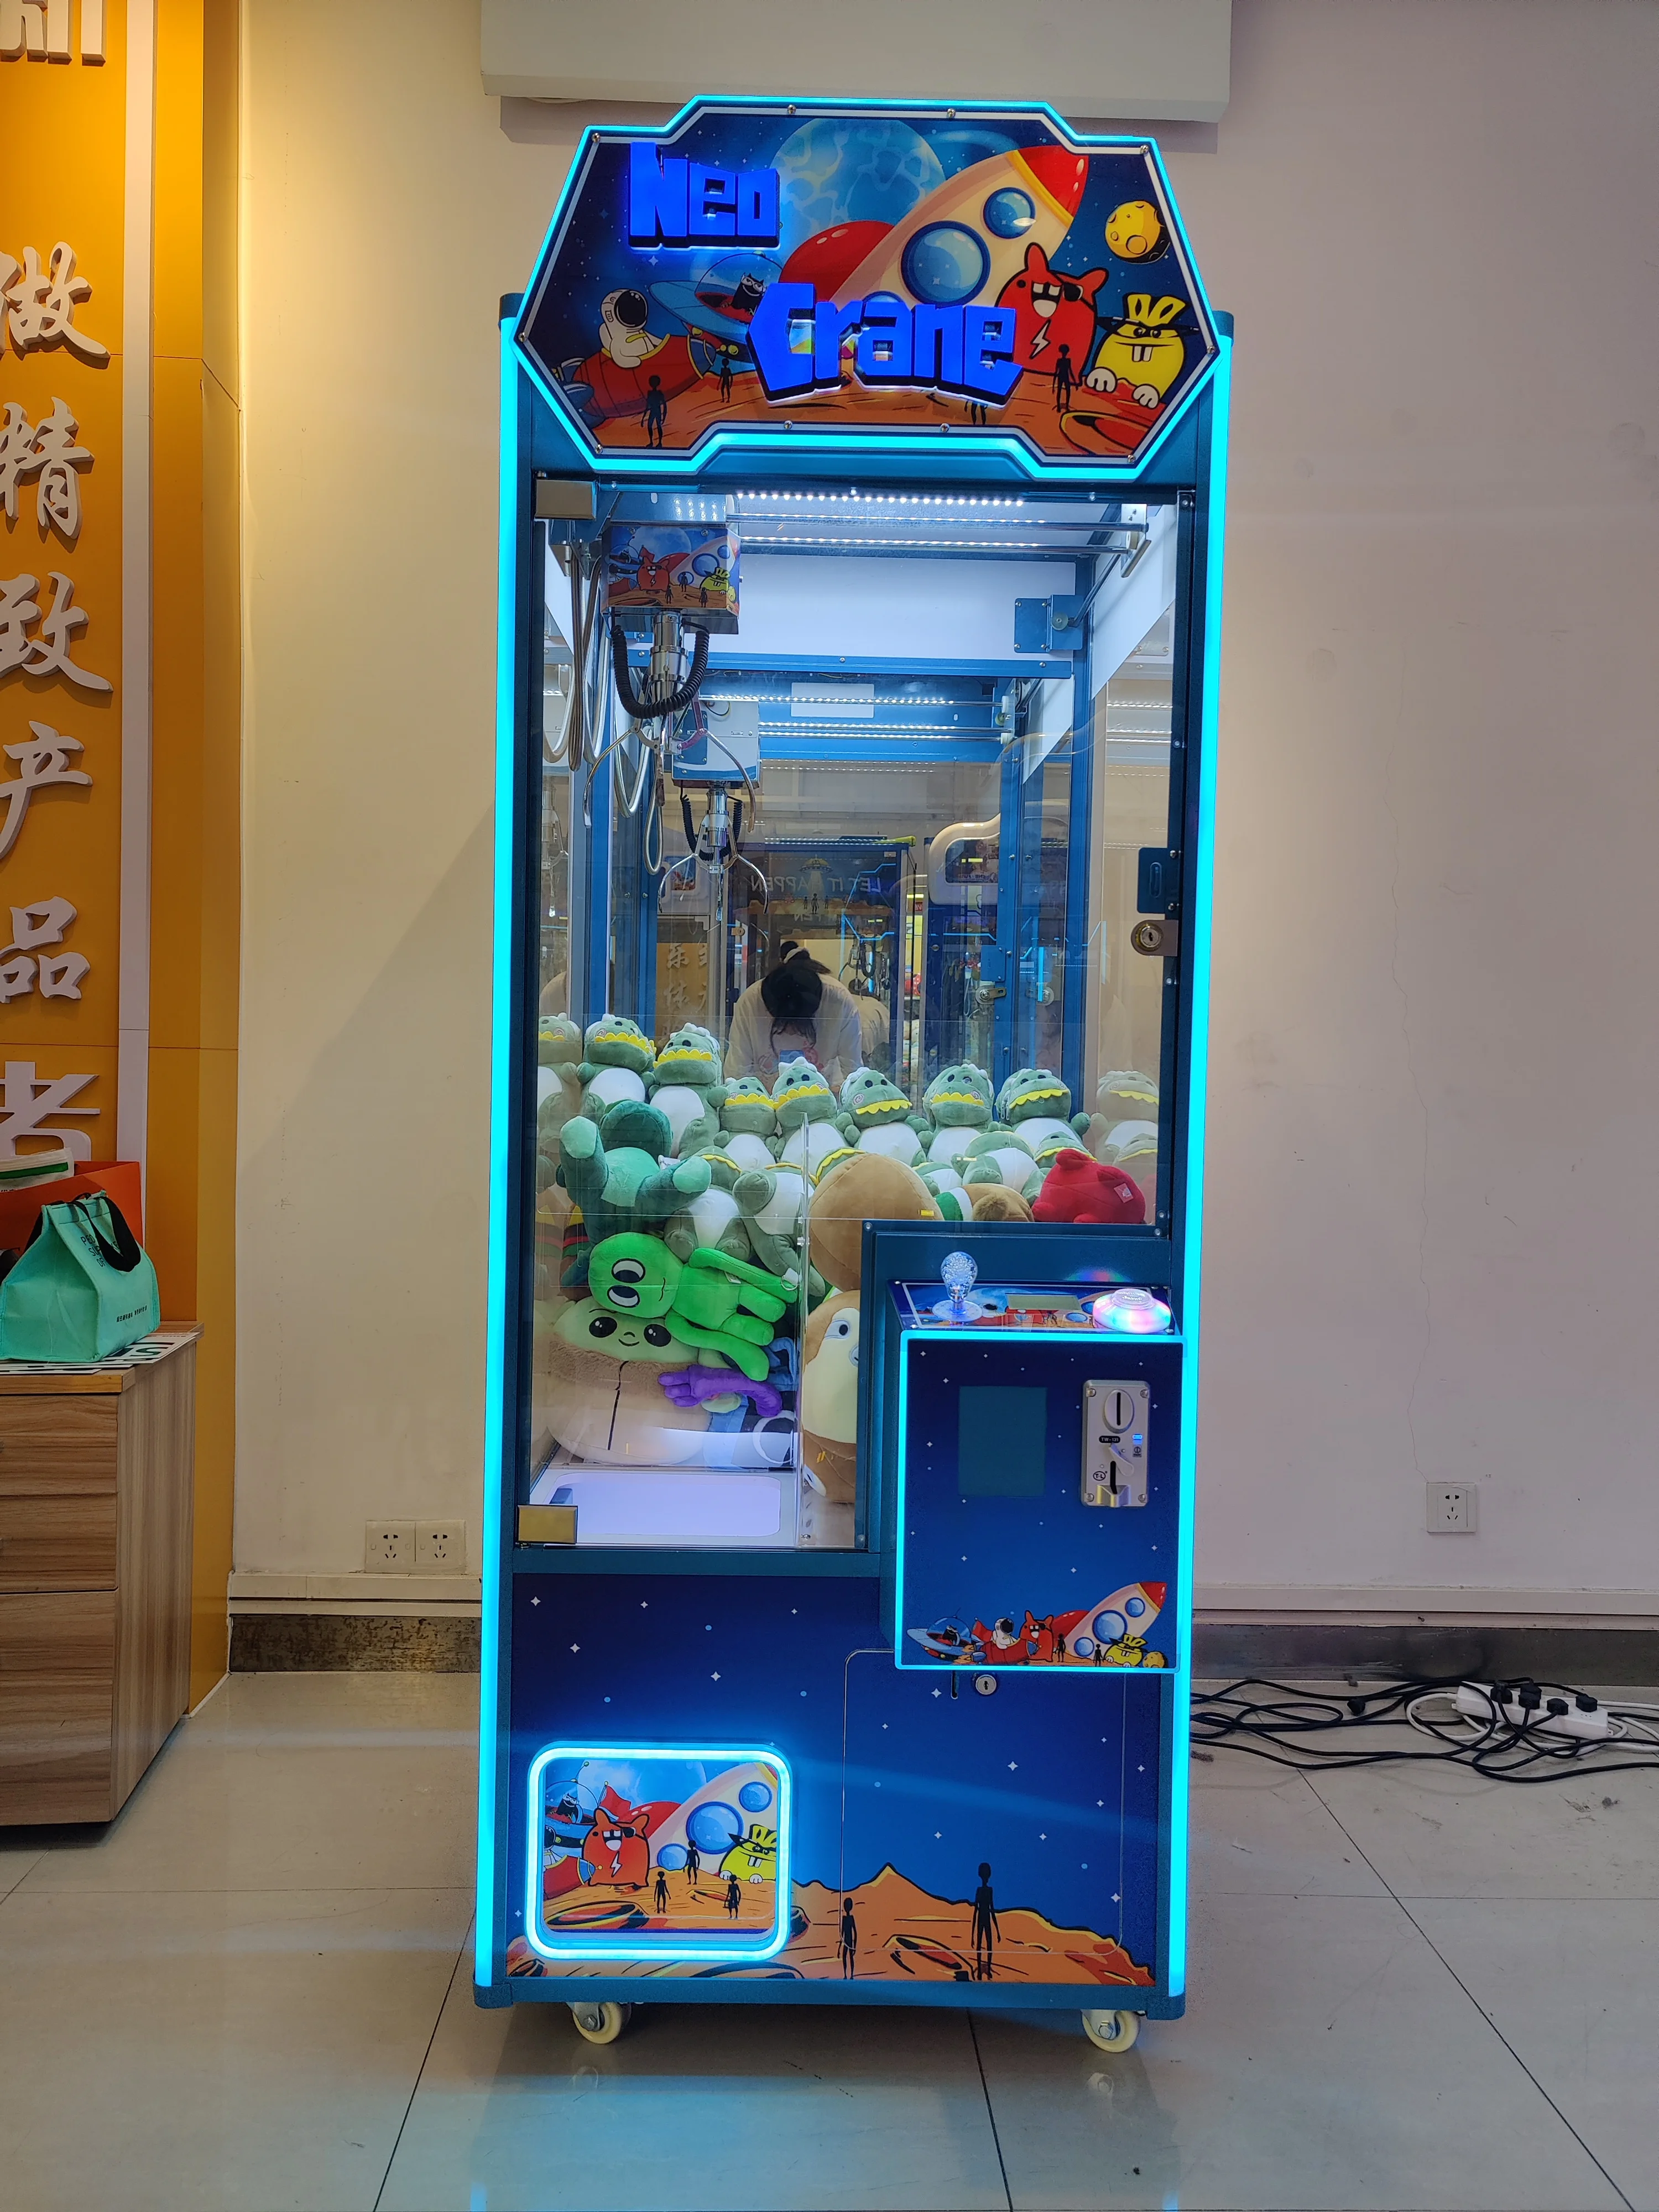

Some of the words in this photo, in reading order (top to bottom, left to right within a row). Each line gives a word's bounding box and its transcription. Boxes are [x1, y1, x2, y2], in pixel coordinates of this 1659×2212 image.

[628, 141, 779, 247] Neo
[747, 282, 1024, 401] Crane
[80, 1234, 96, 1246] PEO
